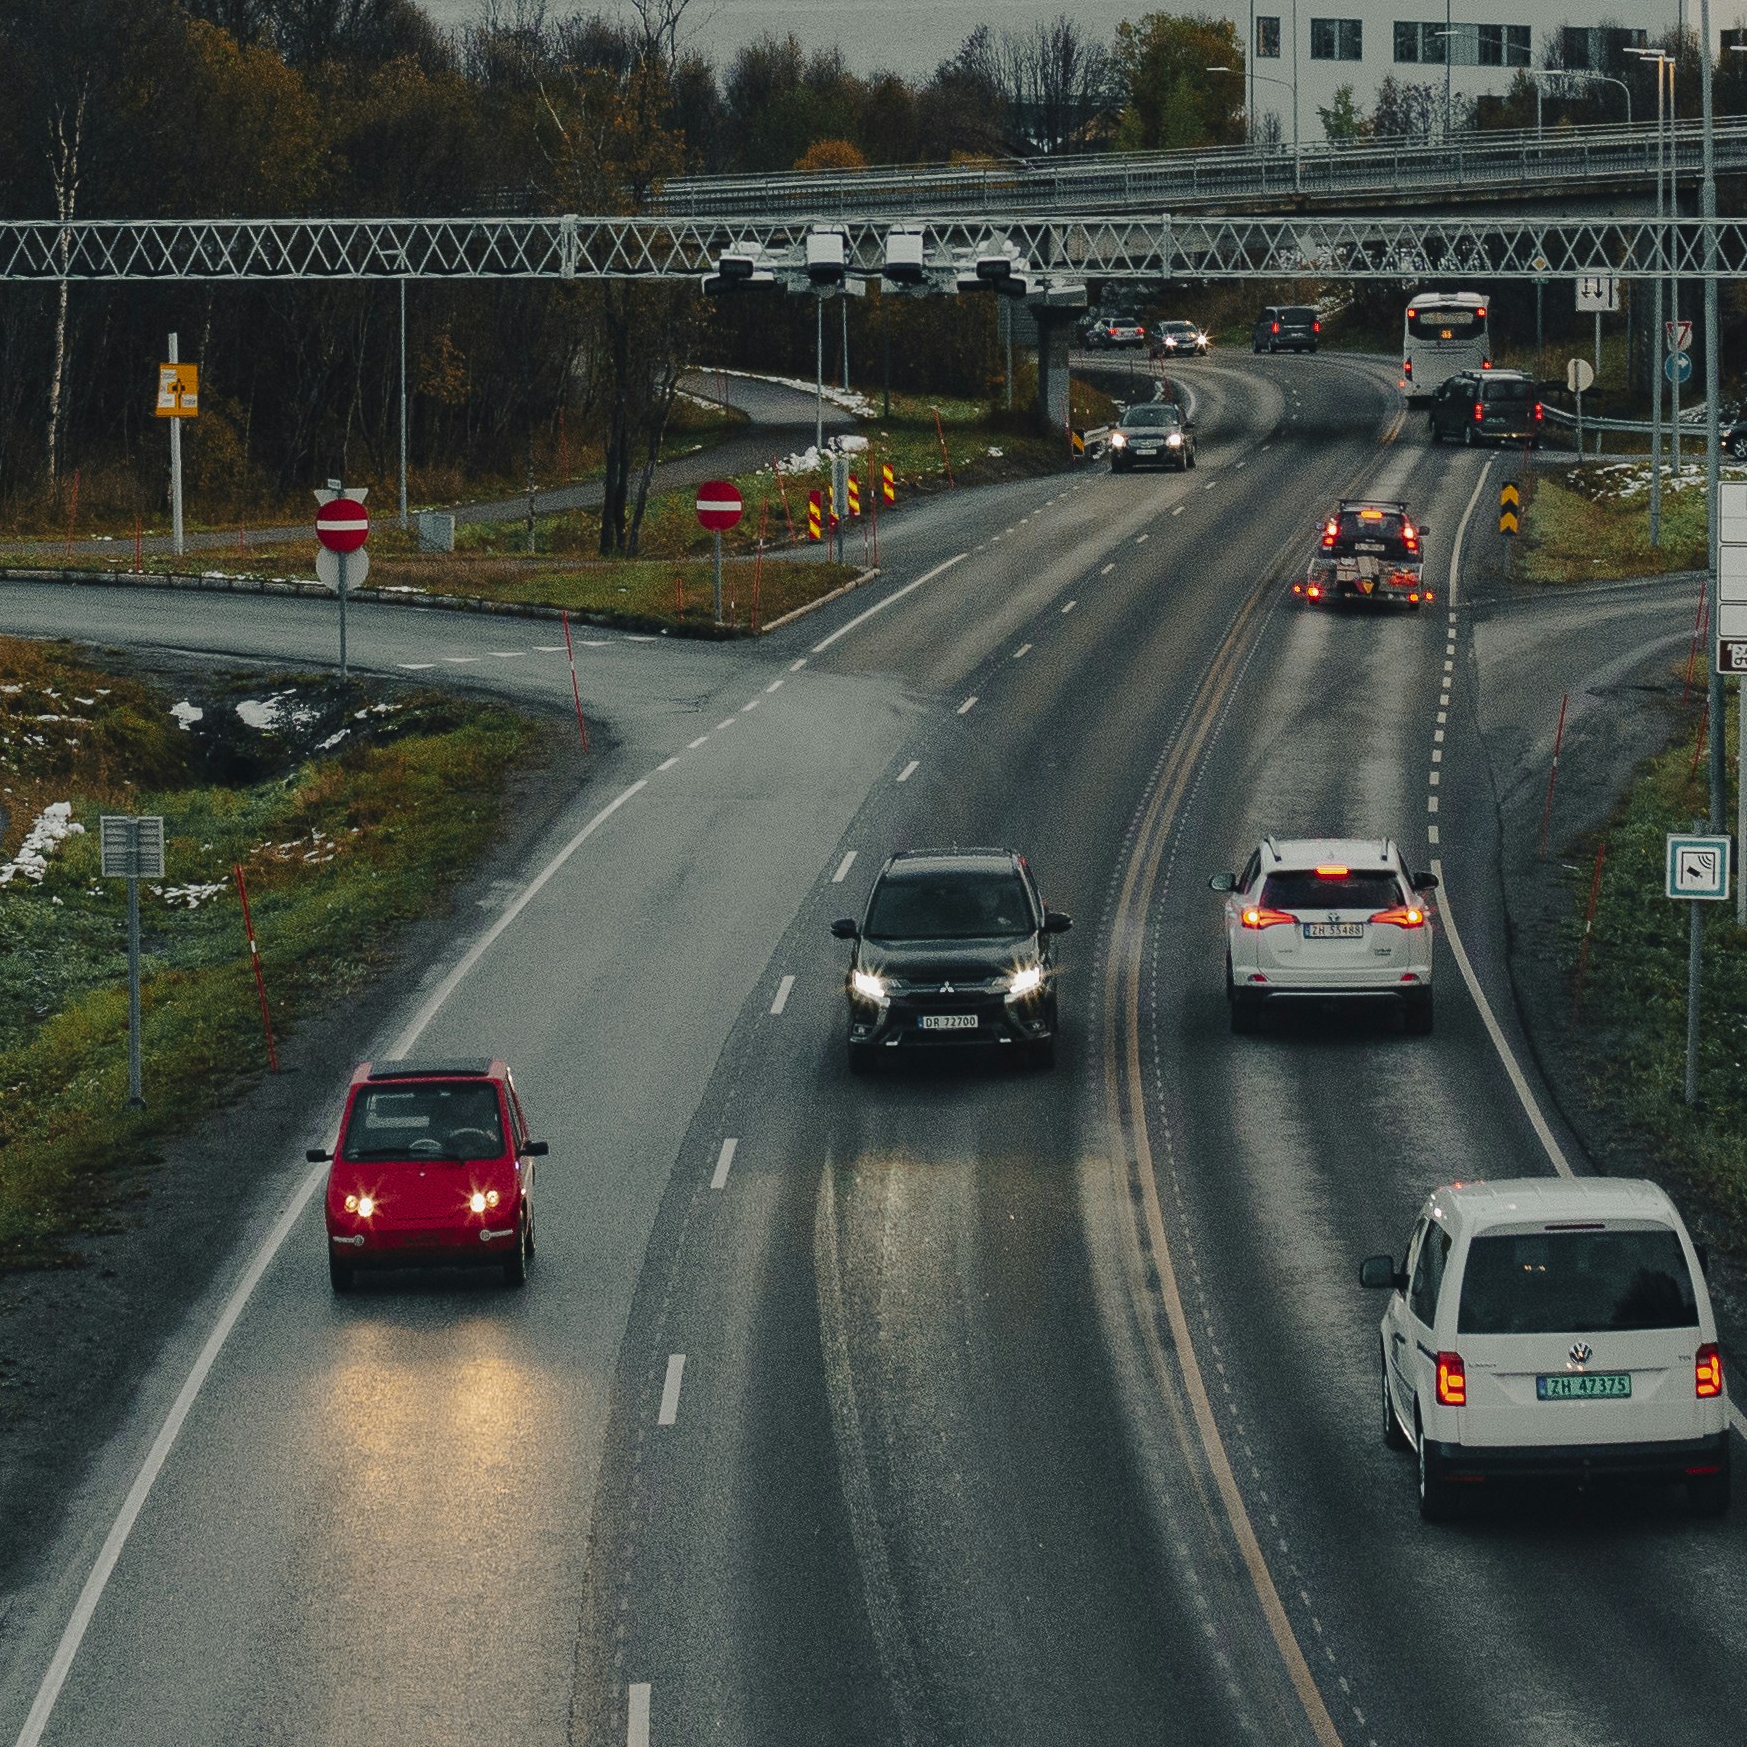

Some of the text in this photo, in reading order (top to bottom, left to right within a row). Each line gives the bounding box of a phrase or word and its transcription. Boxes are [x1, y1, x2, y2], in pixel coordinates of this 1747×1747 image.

[1312, 926, 1325, 935] ZH
[926, 1017, 976, 1027] DR 72700
[1551, 1376, 1627, 1395] ZH 47375
